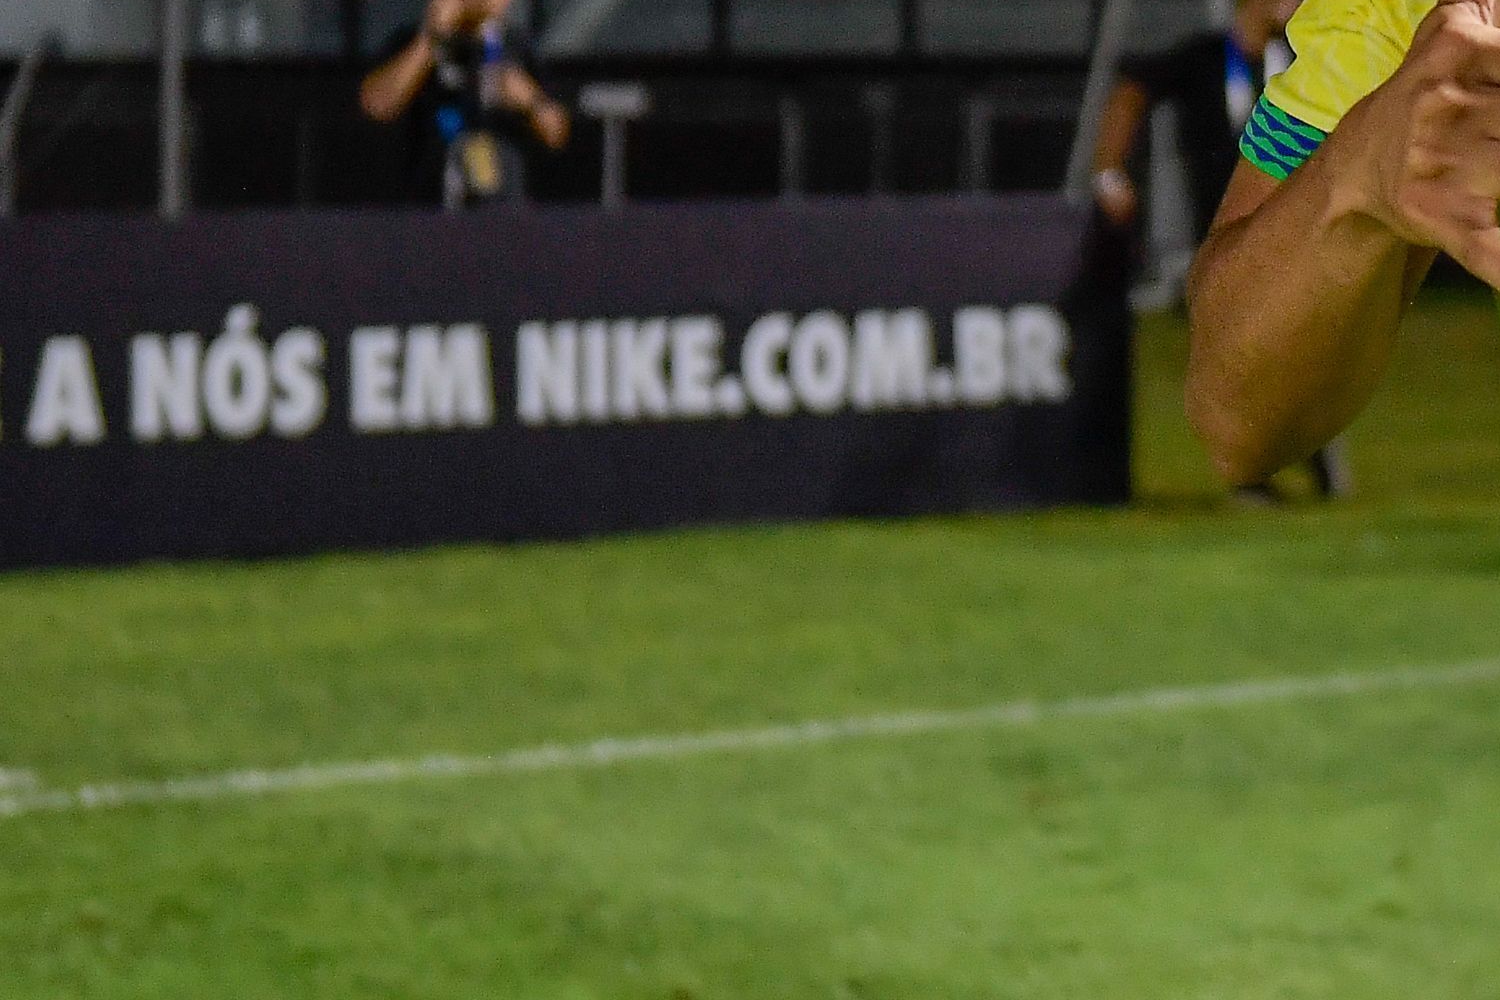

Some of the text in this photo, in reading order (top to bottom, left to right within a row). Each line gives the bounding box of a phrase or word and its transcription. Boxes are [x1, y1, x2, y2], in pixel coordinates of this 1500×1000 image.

[27, 336, 103, 444] A
[131, 304, 325, 439] NÓS
[349, 323, 493, 430] EM
[516, 304, 1068, 424] NIKE.COM.BR
